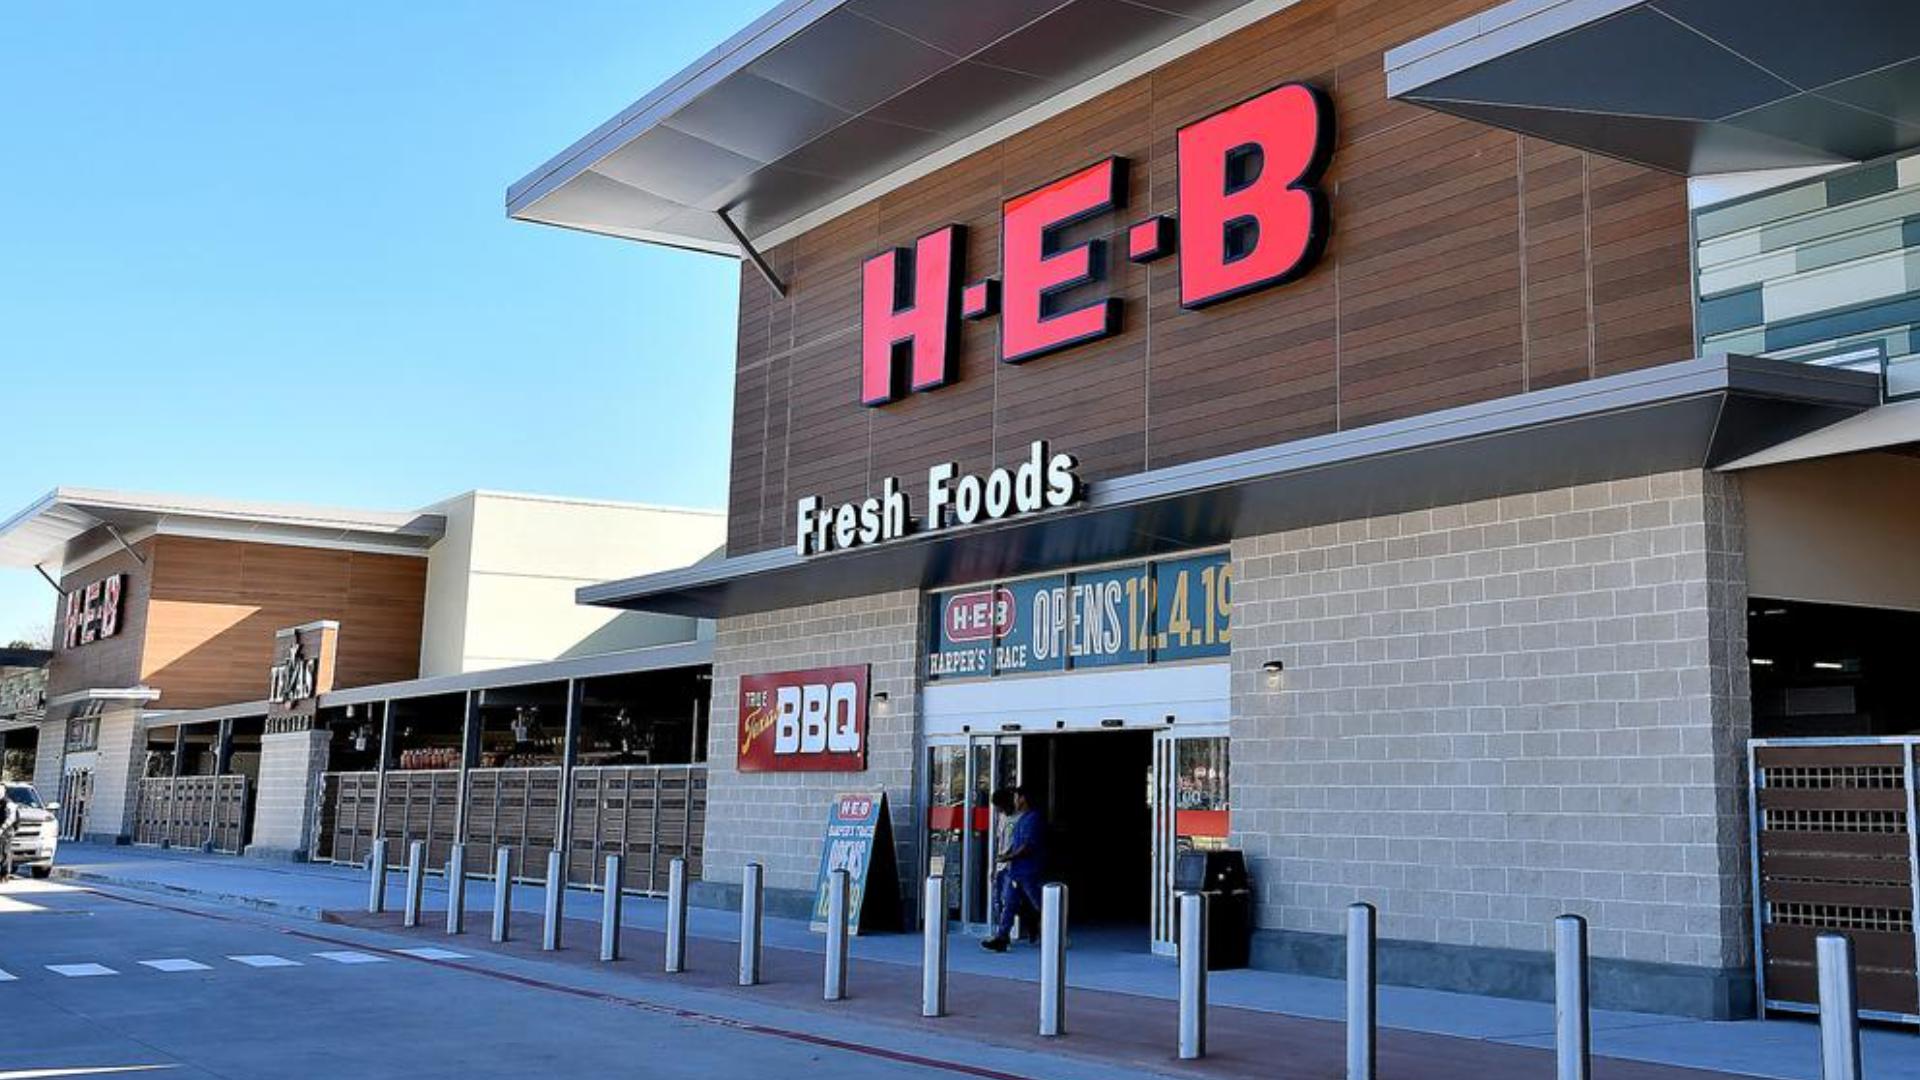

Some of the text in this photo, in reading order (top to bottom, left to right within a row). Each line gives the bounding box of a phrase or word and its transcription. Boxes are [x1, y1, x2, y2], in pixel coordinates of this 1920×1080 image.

[797, 440, 1077, 556] Fresh Foods
[1033, 580, 1122, 661] OPENS
[930, 645, 1027, 675] HARPER'S RACE
[774, 682, 860, 753] BBQ
